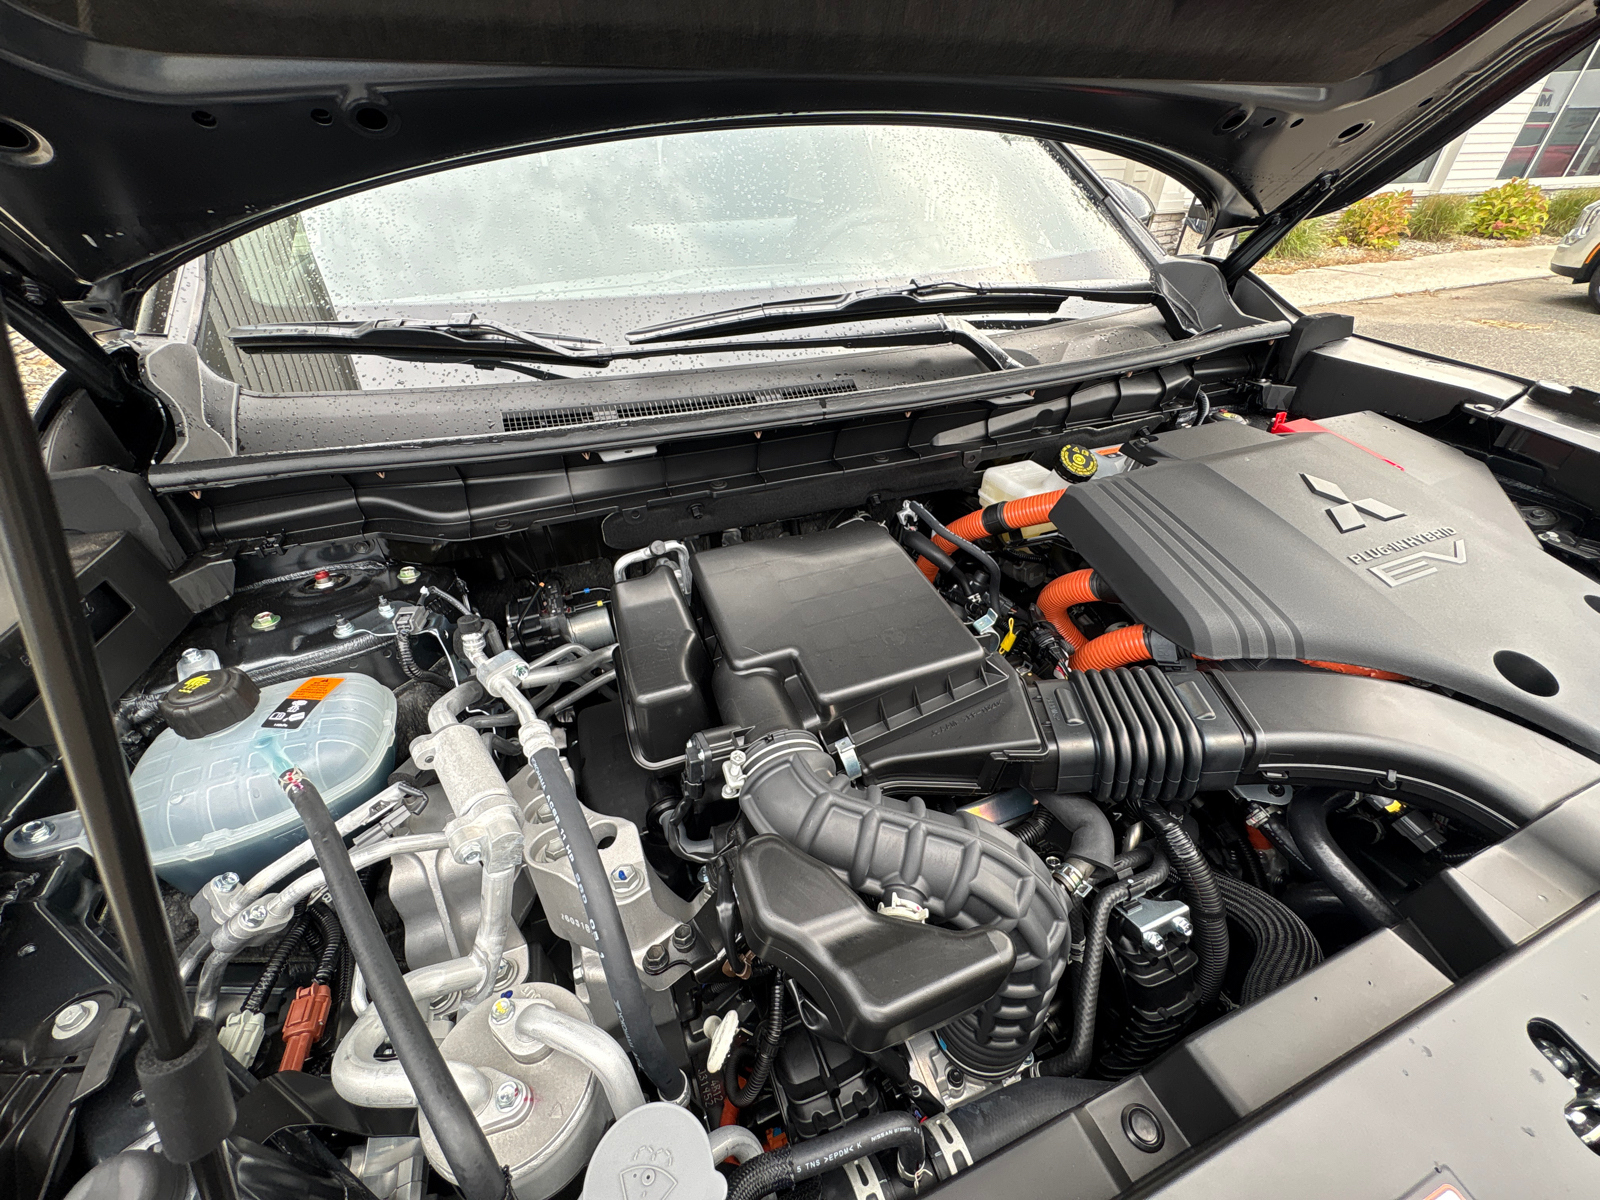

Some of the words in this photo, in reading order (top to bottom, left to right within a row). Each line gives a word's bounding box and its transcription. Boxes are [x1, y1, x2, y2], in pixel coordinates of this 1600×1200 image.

[1366, 539, 1467, 588] EV
[805, 1159, 821, 1171] TNS
[870, 1129, 894, 1142] NISSAN
